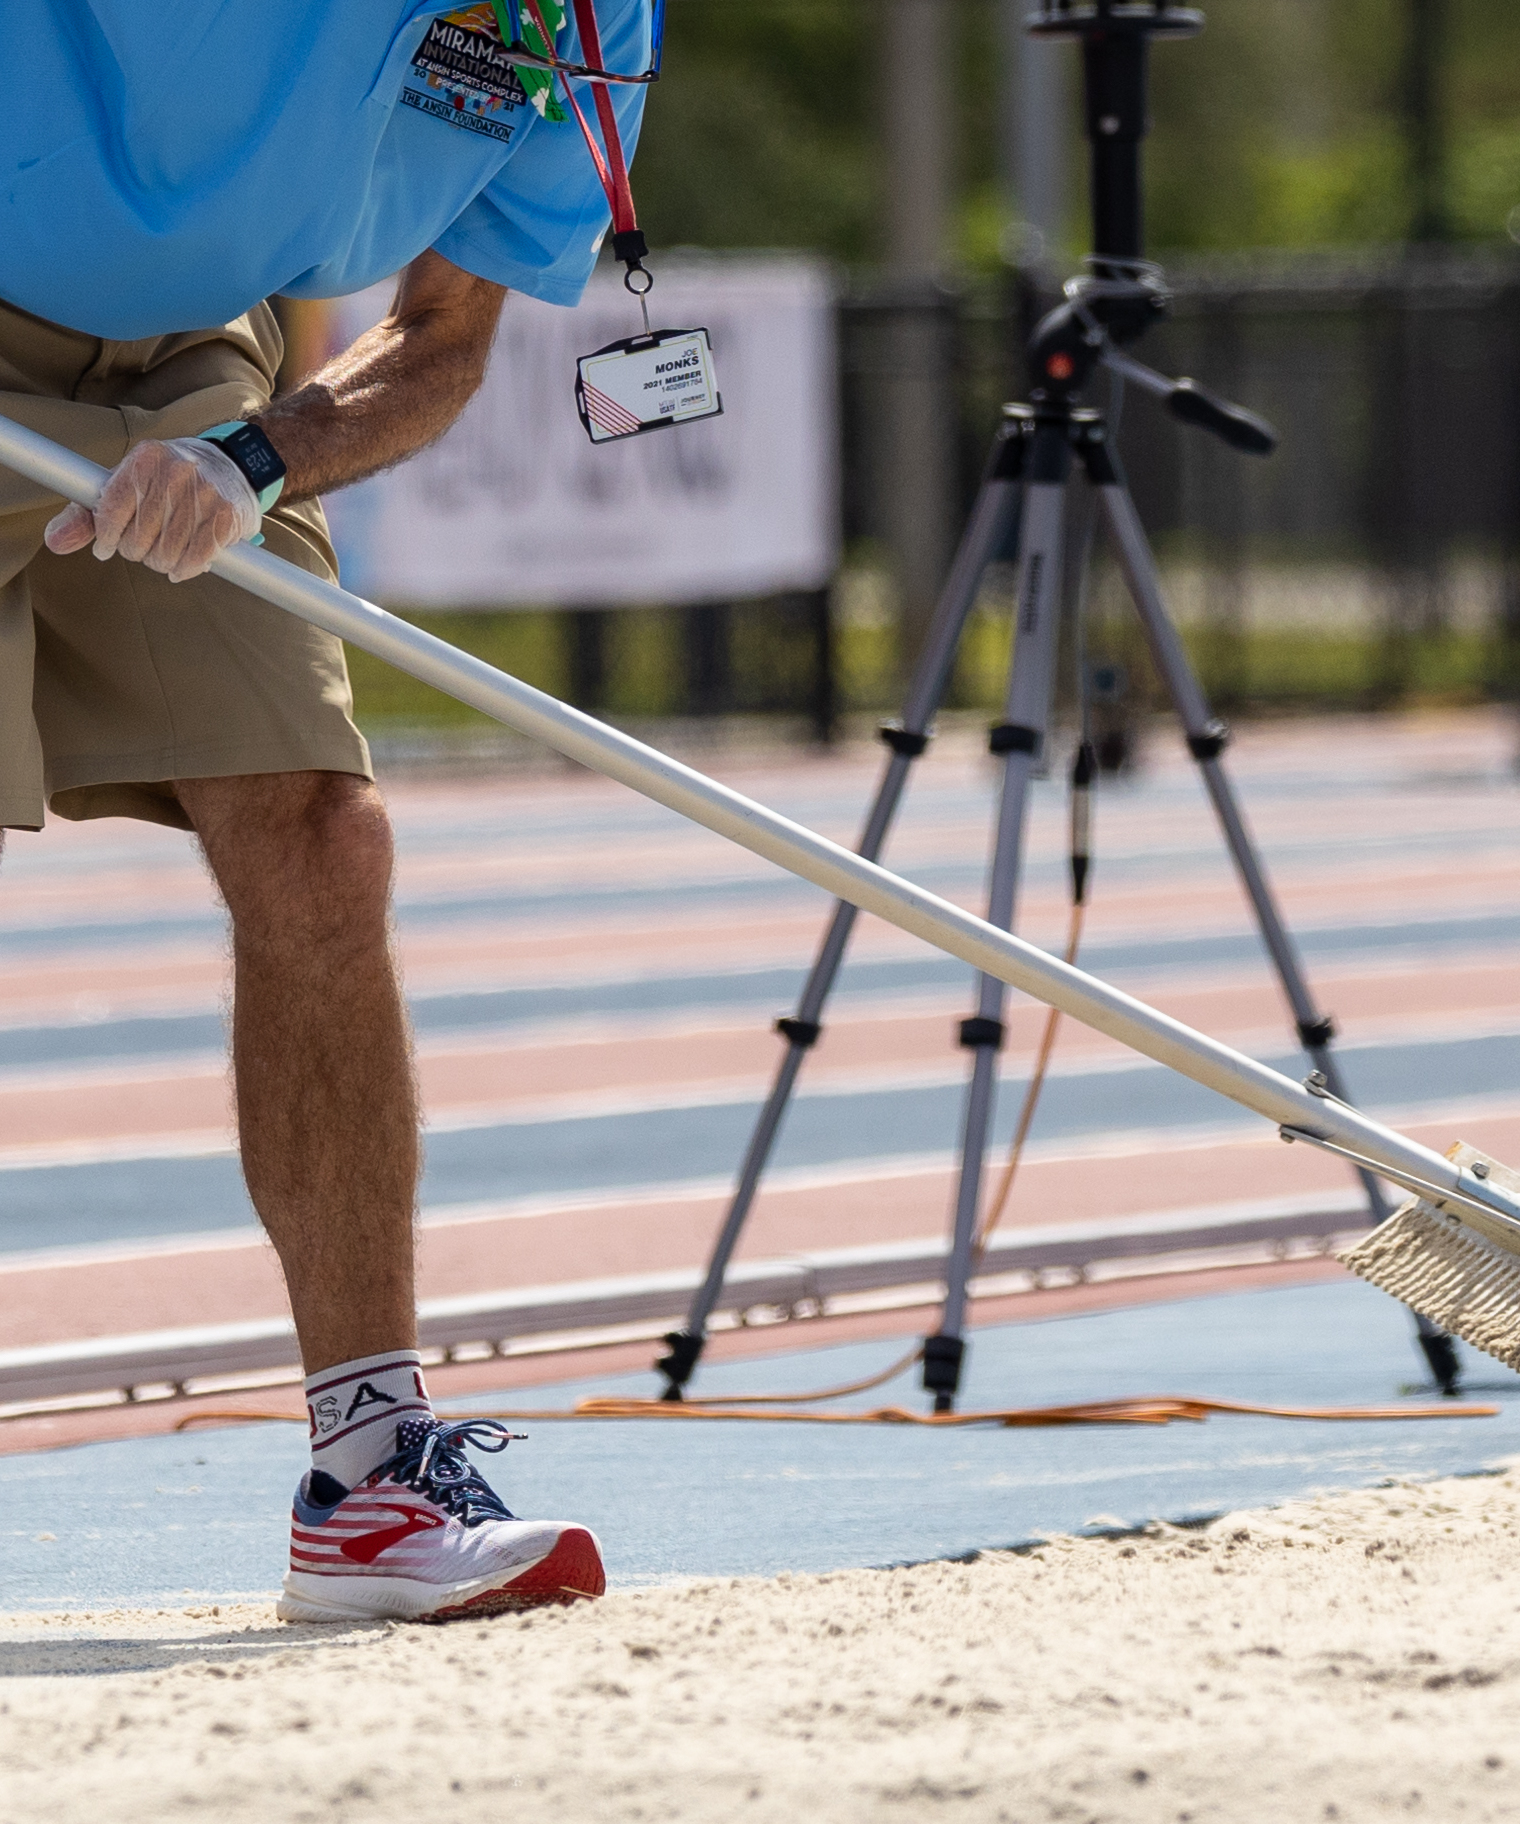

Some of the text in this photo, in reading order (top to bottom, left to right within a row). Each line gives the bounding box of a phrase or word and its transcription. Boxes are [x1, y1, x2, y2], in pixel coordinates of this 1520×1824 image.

[413, 68, 427, 79] 20
[423, 41, 521, 90] INVITATIONAL
[416, 57, 524, 103] AT ANSIN SPORTS COMPLEX
[402, 90, 421, 106] THE
[422, 101, 453, 119] ANSIN
[453, 110, 512, 140] FOUNDATION
[504, 102, 515, 113] 21
[681, 348, 698, 358] JOE
[655, 356, 699, 374] MONKS
[643, 370, 701, 390] 2021 MEMBER
